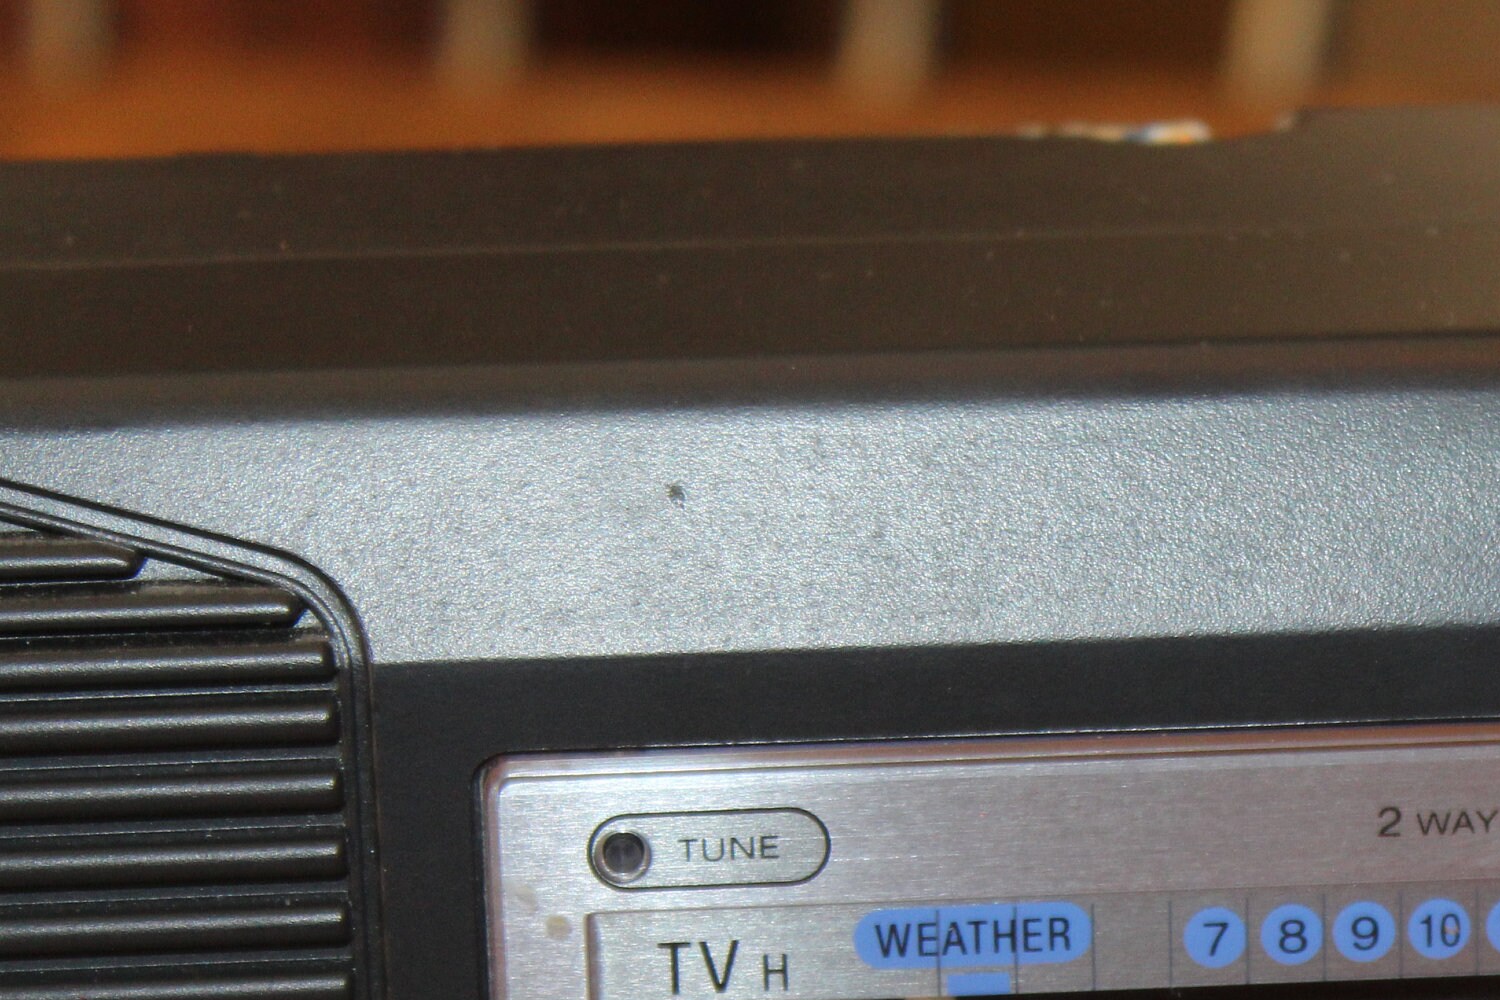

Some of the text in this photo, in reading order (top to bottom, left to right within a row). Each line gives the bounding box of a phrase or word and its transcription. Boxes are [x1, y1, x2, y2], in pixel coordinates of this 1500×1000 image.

[1378, 806, 1401, 838] 2
[1417, 809, 1499, 836] WAY
[678, 834, 781, 863] TUNE
[875, 916, 1072, 959] WEATHER
[1203, 921, 1229, 956] 7
[1279, 918, 1308, 954] 8
[1351, 916, 1379, 950] 9
[1419, 912, 1462, 948] 10
[657, 939, 739, 995] TV
